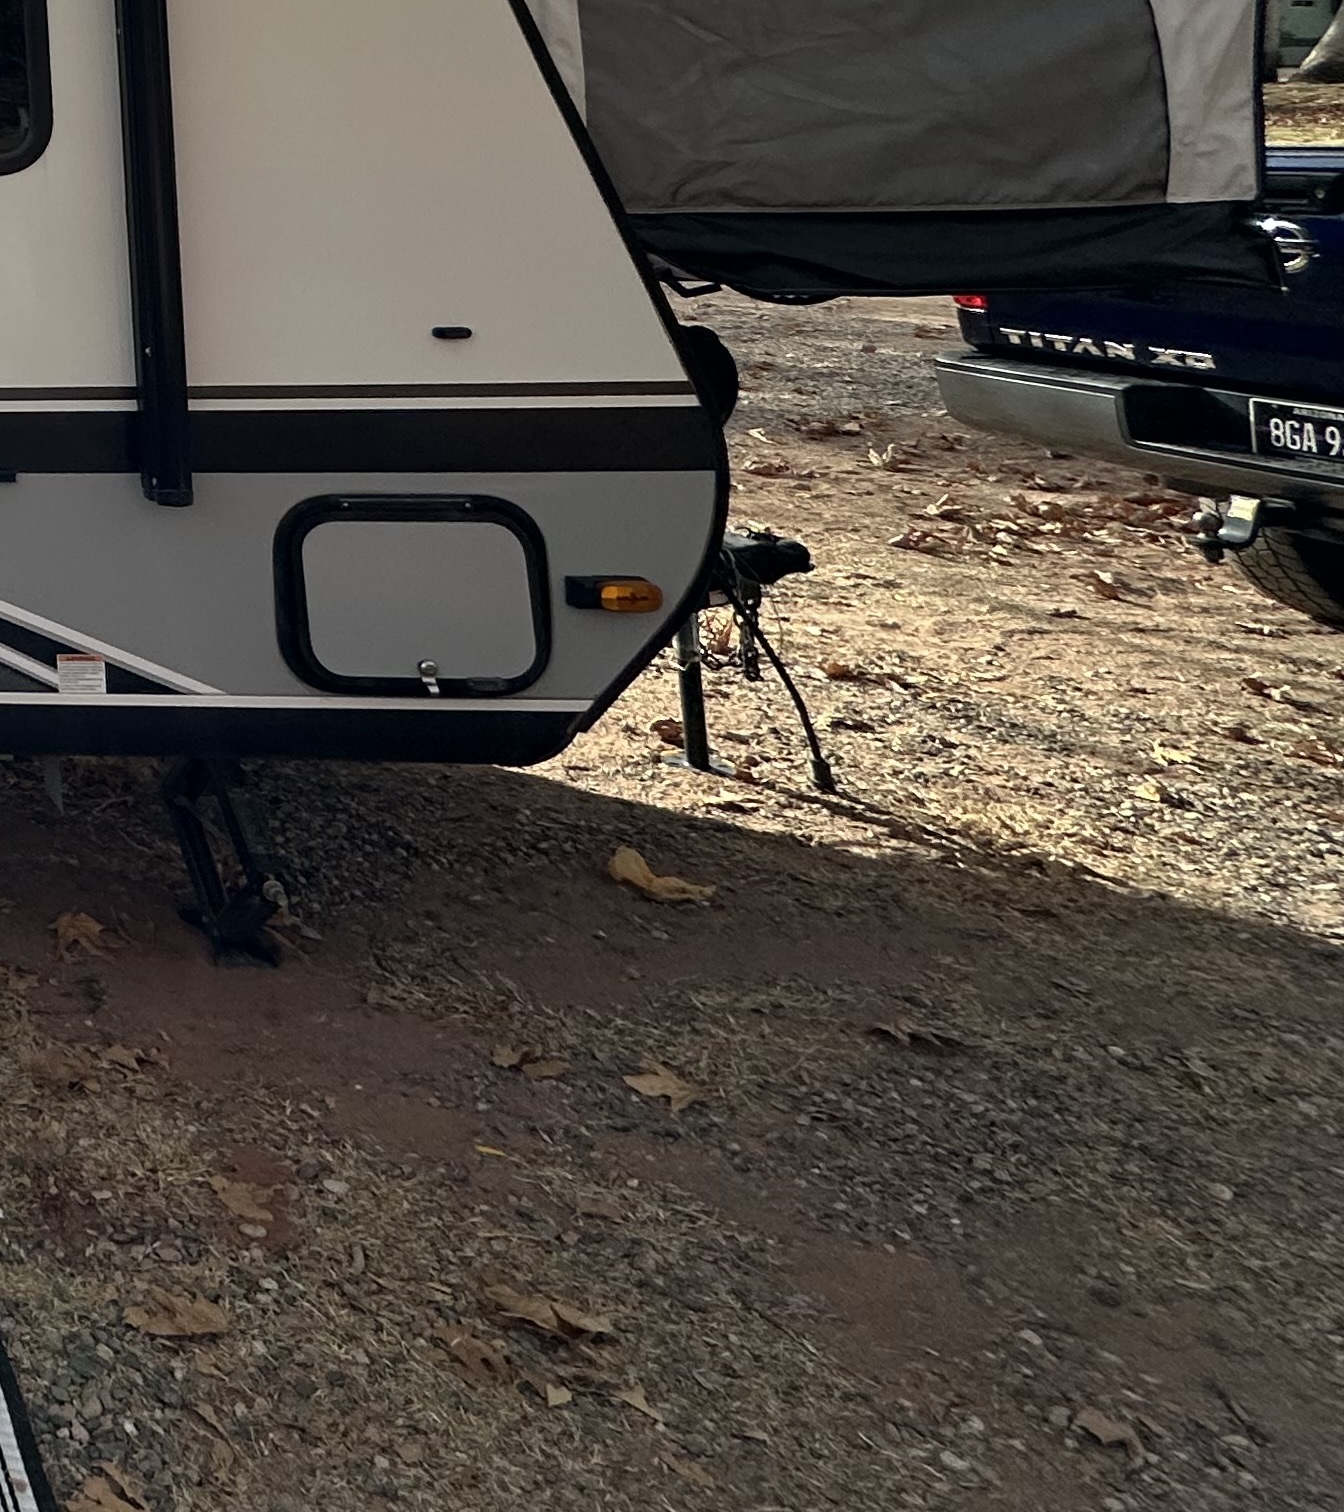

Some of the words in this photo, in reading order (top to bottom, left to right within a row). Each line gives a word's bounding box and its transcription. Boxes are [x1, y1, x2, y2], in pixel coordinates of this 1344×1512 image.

[999, 327, 1135, 360] TITAN
[1270, 418, 1318, 453] 8GA
[1325, 426, 1344, 456] 9
